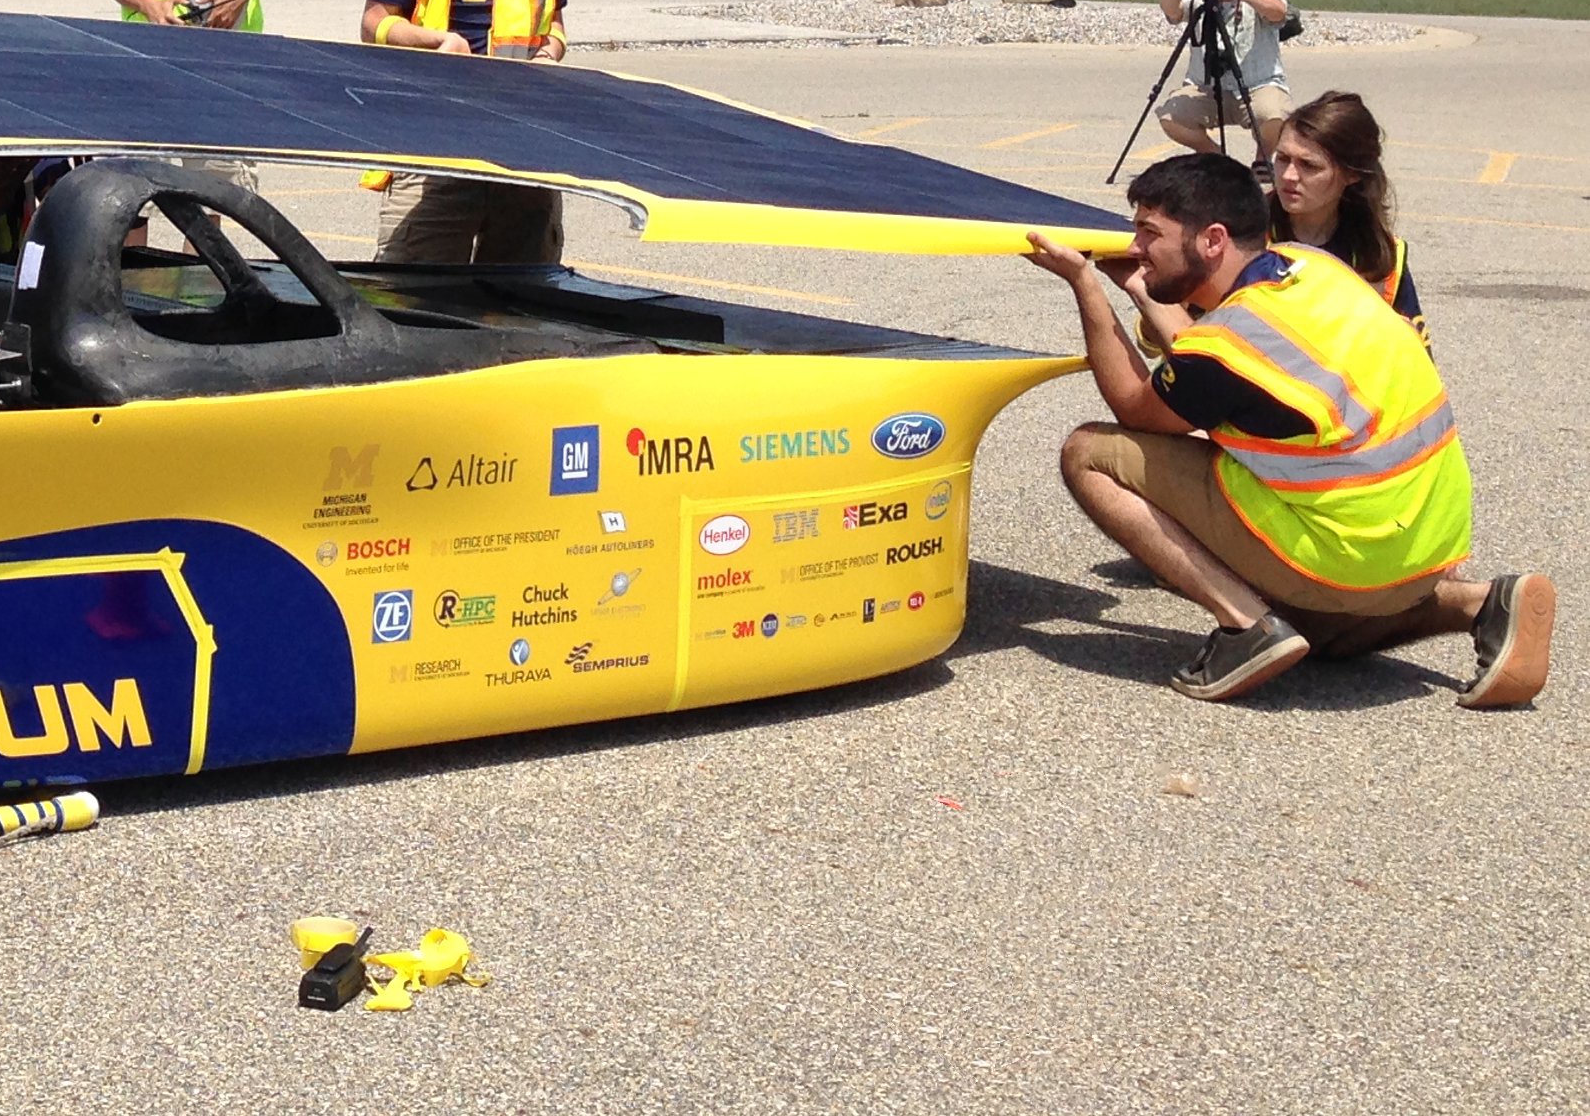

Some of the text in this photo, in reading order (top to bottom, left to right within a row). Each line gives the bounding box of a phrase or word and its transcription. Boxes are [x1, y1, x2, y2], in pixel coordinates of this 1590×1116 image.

[740, 428, 850, 463] SIEMENS
[886, 420, 932, 452] Ford
[562, 441, 589, 471] GM
[446, 452, 518, 489] Altair
[322, 493, 367, 506] MICHIGAN
[313, 505, 371, 519] ENGINEERING
[608, 517, 619, 526] H
[859, 502, 908, 527] Exa
[703, 525, 746, 544] Henkel
[772, 508, 819, 544] IBM
[347, 537, 410, 560] BOSCH
[453, 529, 560, 550] OFFICE OF THE PRESIDENT
[886, 536, 943, 565] ROUSH
[345, 561, 410, 576] Invented for life
[799, 552, 879, 576] OFFICE OF THE PROVOST
[697, 567, 752, 590] molex
[522, 582, 569, 604] Chuck
[511, 606, 578, 628] Hutchins
[731, 620, 755, 639] 3M
[415, 659, 461, 675] RESEARCH
[572, 654, 650, 673] SEMPRIUS
[485, 667, 552, 687] THURAYA
